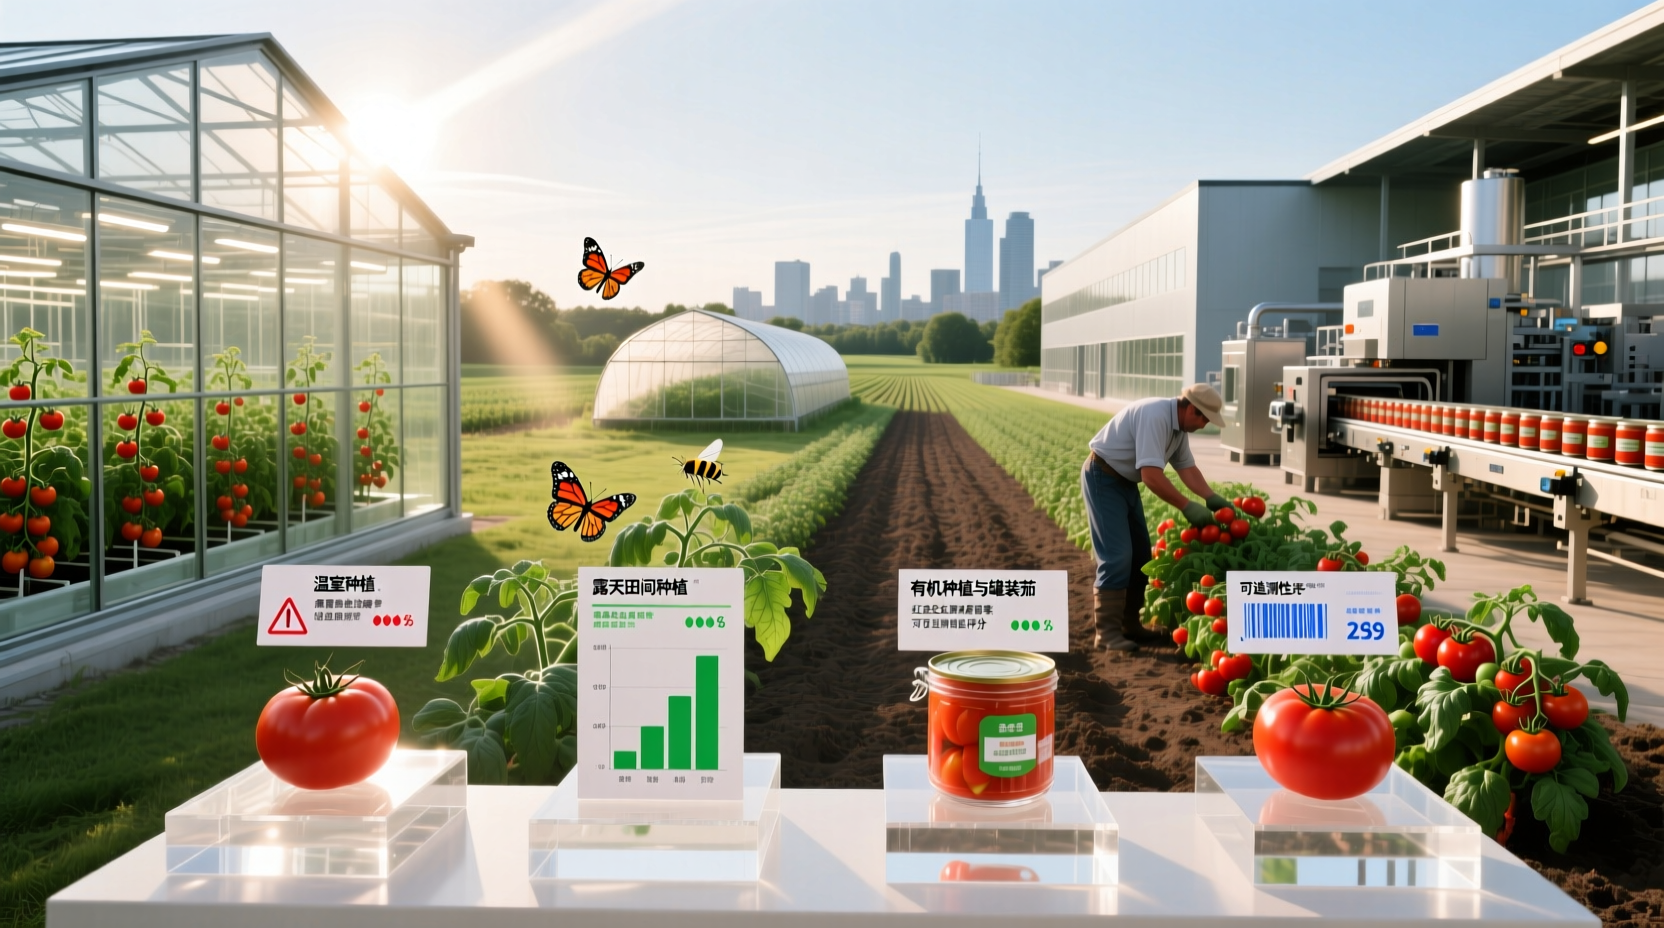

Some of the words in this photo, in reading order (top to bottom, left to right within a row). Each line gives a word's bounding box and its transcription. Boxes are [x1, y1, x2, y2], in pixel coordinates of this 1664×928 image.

[313, 575, 376, 593] 温室种植
[592, 578, 688, 596] 露天田间种植
